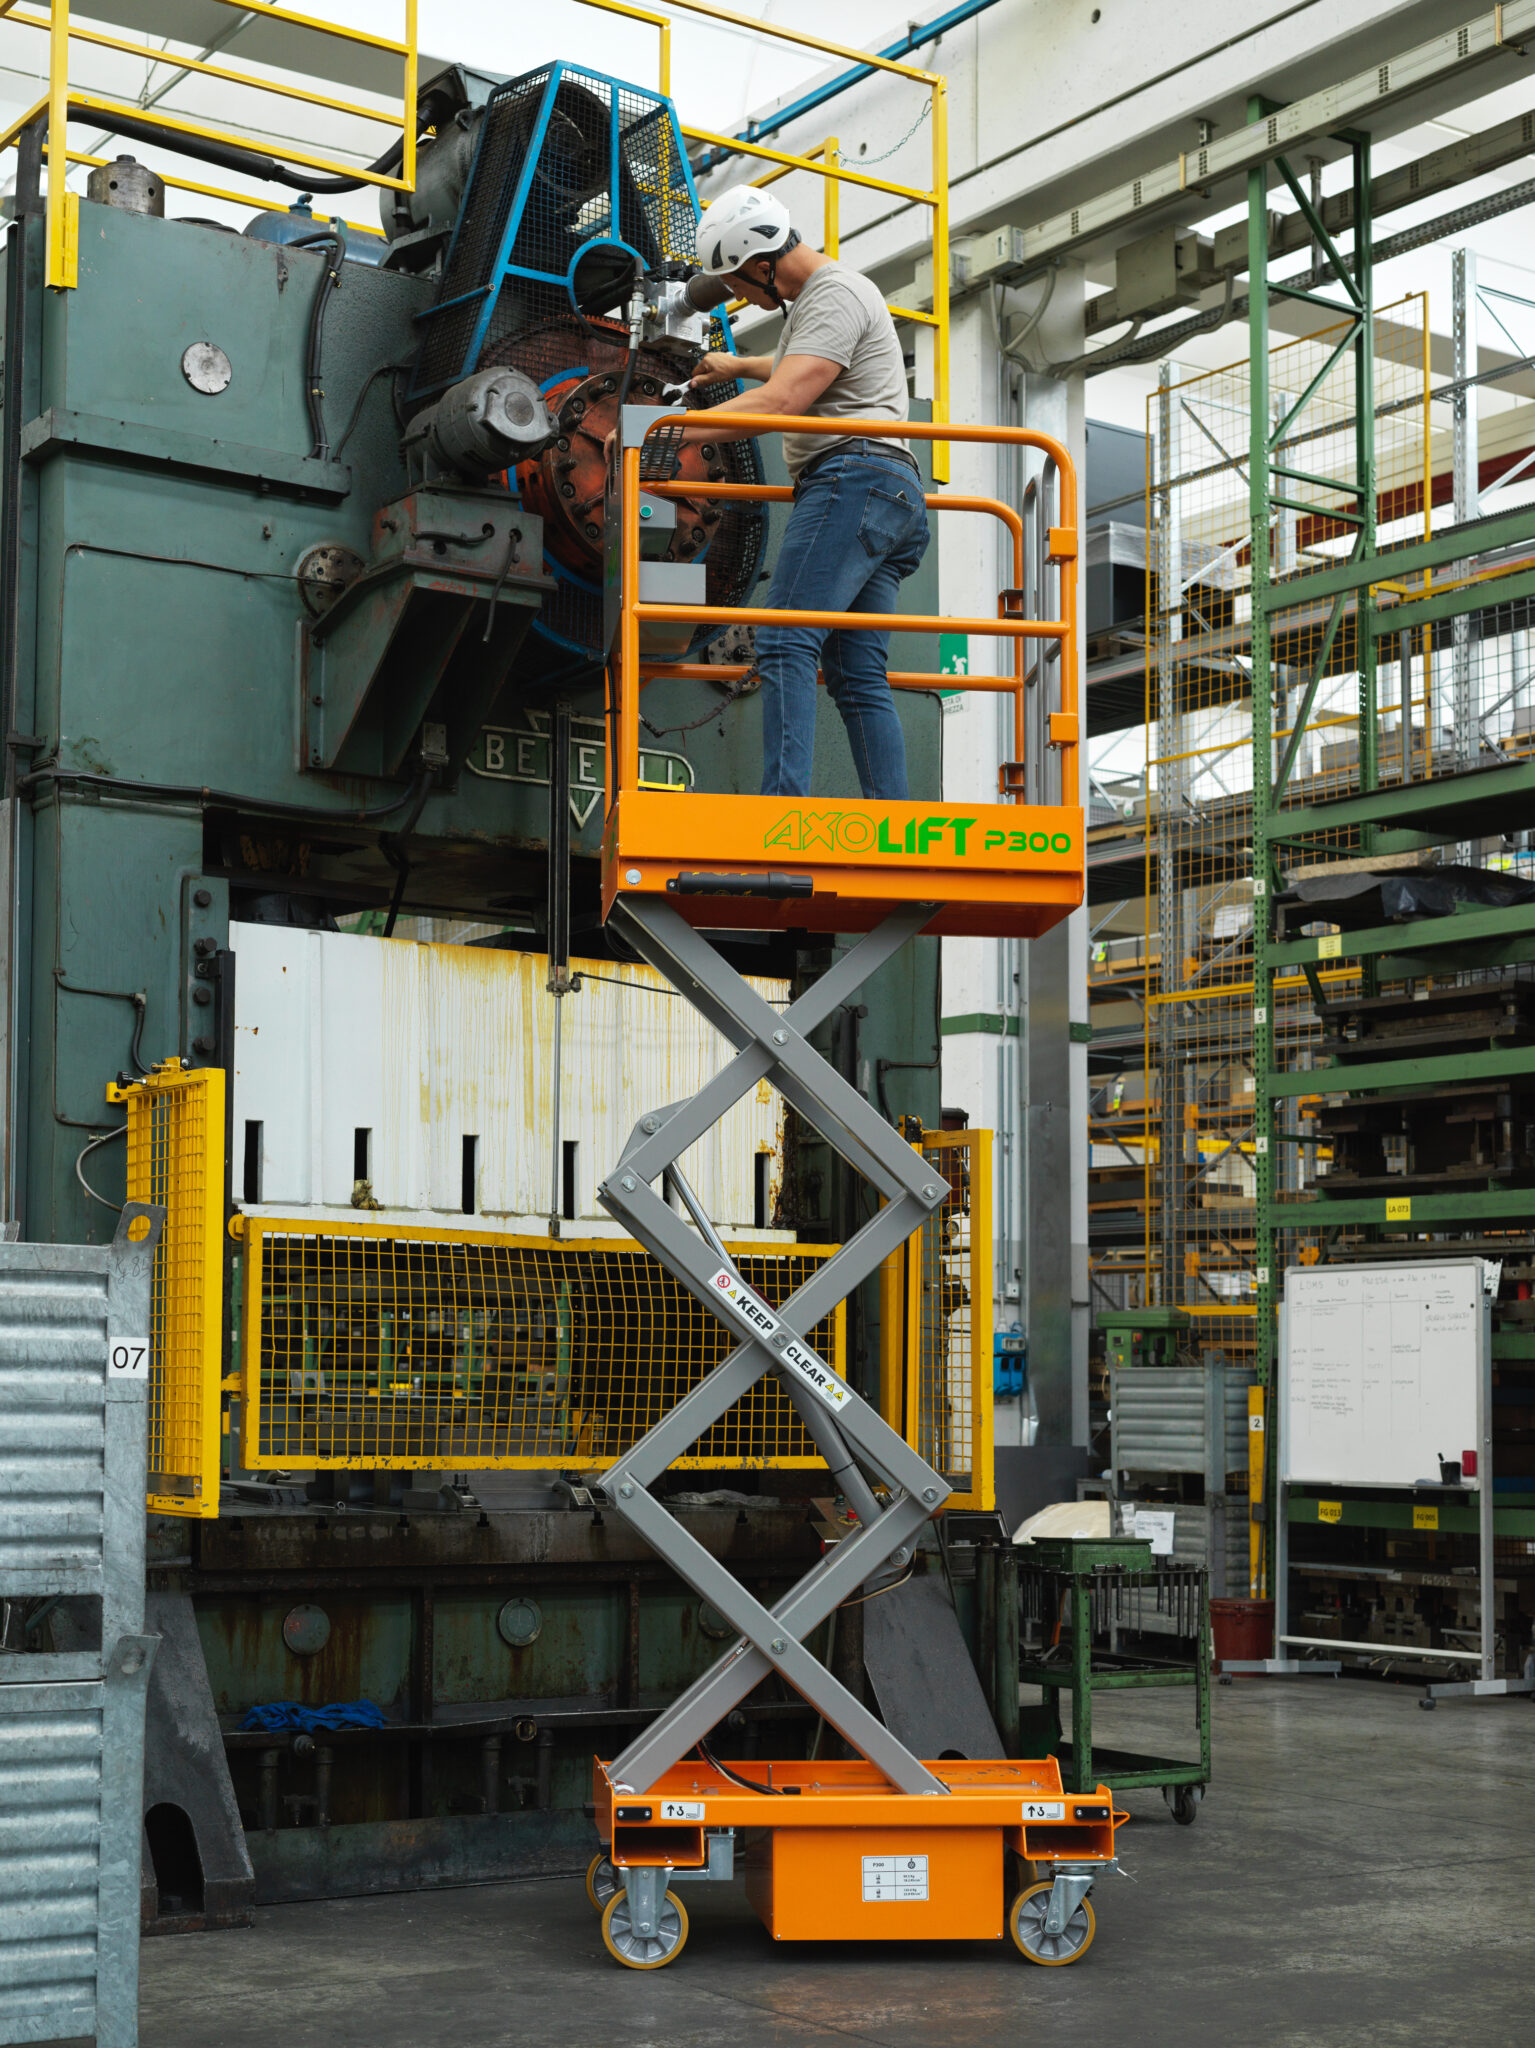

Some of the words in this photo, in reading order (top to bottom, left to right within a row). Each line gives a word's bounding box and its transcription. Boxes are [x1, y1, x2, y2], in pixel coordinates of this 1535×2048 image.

[764, 810, 978, 856] AXOLIFT
[984, 829, 1072, 854] P300
[736, 1295, 774, 1331] KEEP
[112, 1346, 146, 1370] 07
[787, 1346, 826, 1387] CLEAR
[1254, 1418, 1261, 1428] 2
[1320, 1507, 1329, 1516] FG
